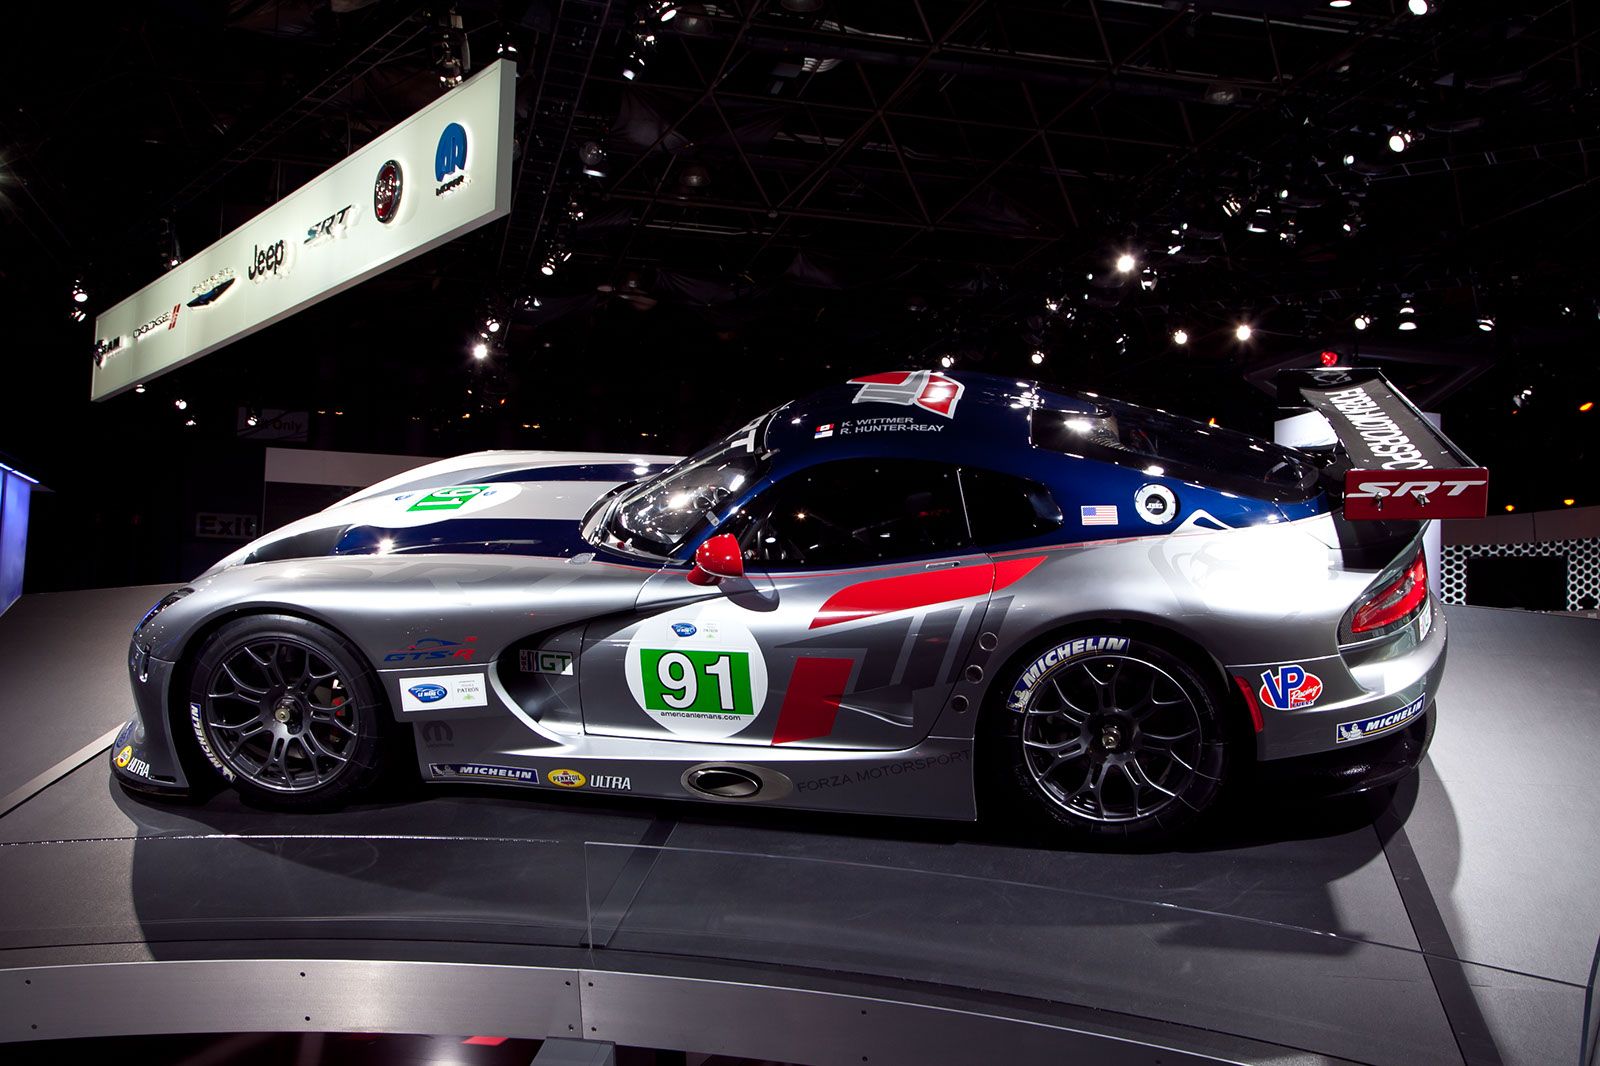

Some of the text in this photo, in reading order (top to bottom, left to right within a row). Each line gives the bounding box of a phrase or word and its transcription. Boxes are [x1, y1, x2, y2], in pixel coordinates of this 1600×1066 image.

[303, 204, 352, 244] SRT
[248, 239, 285, 281] Jeep
[855, 424, 944, 434] HUNTER-REAY
[856, 417, 914, 425] WITTMER
[1346, 480, 1488, 503] SRT
[199, 515, 256, 537] Exit
[384, 648, 477, 662] GTS-R
[541, 653, 572, 672] GT
[1021, 637, 1127, 688] MICHELIN
[656, 651, 736, 711] 91
[1261, 664, 1306, 710] VP
[660, 711, 742, 721] americanlemans.com
[1365, 699, 1423, 732] MICHELIN
[190, 704, 223, 769] MICHELIN
[459, 766, 532, 779] MICHELIN
[590, 774, 631, 790] ULTRA
[797, 750, 971, 793] FORZA MOTORSPORT
